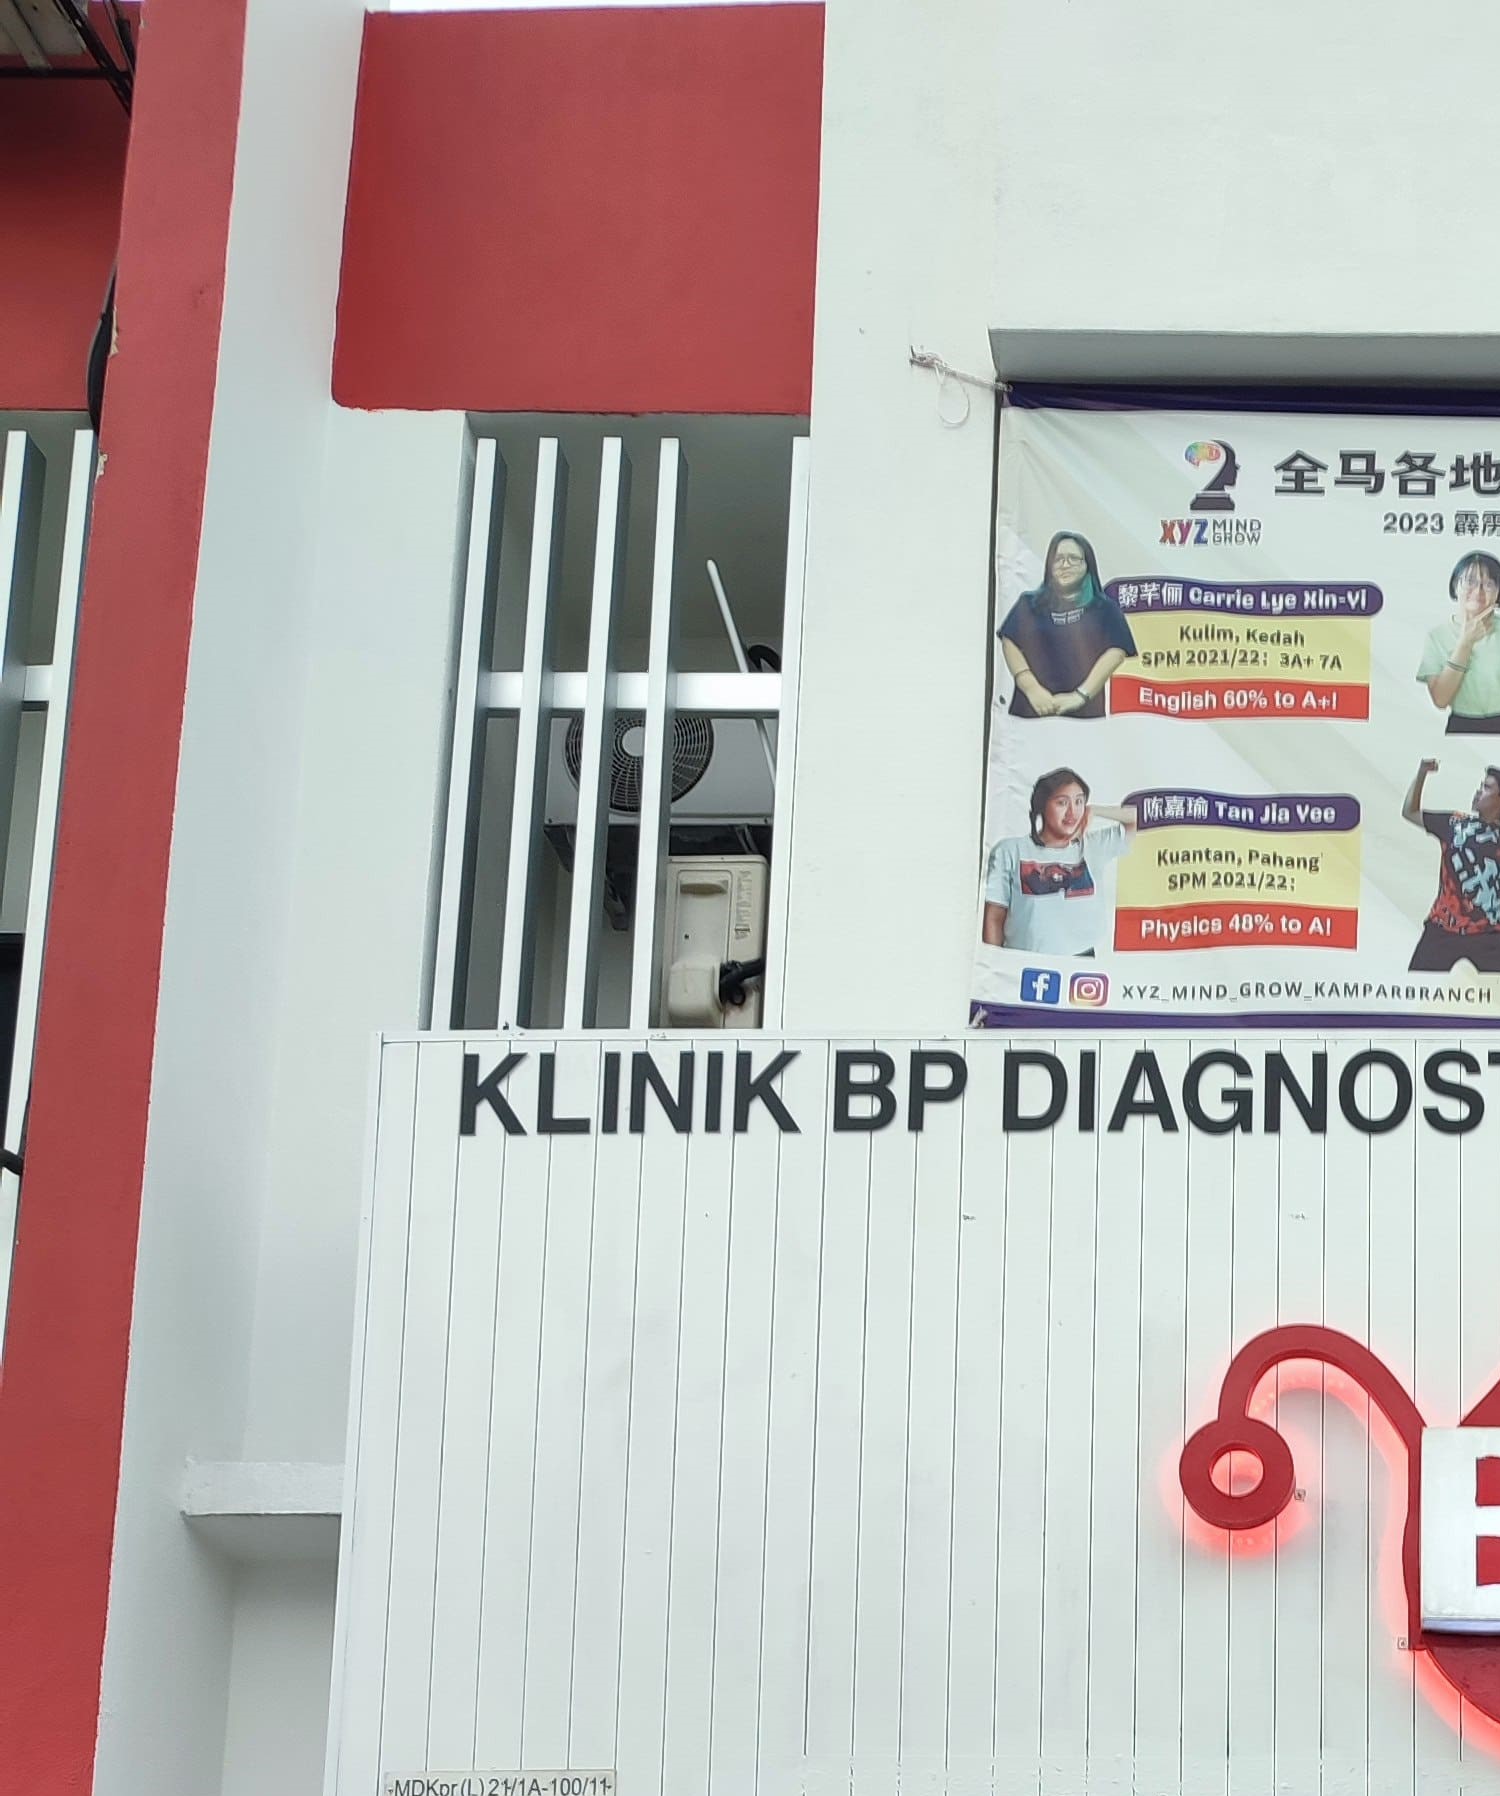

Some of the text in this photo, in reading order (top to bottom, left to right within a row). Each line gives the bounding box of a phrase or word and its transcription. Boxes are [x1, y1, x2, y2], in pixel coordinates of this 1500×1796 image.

[1160, 518, 1262, 547] XYZ MIND GROW
[1383, 512, 1444, 535] 2023
[1189, 586, 1255, 609] Carrie
[1261, 589, 1297, 614] Lye
[1303, 588, 1367, 610] Xin-Yi
[1179, 623, 1305, 647] Kulim, Kedah
[1139, 686, 1217, 714] English
[1223, 689, 1268, 709] 60%
[1274, 691, 1295, 709] to
[1215, 800, 1254, 823] Tan
[1260, 802, 1290, 825] Jia
[1295, 803, 1336, 824] Yee
[1157, 847, 1320, 873] Kuantan, Pahang
[1141, 917, 1222, 943] Physics
[1228, 914, 1274, 934] 48%
[1280, 915, 1301, 934] to
[457, 1047, 803, 1136] KLINIK
[833, 1049, 968, 1133] BP
